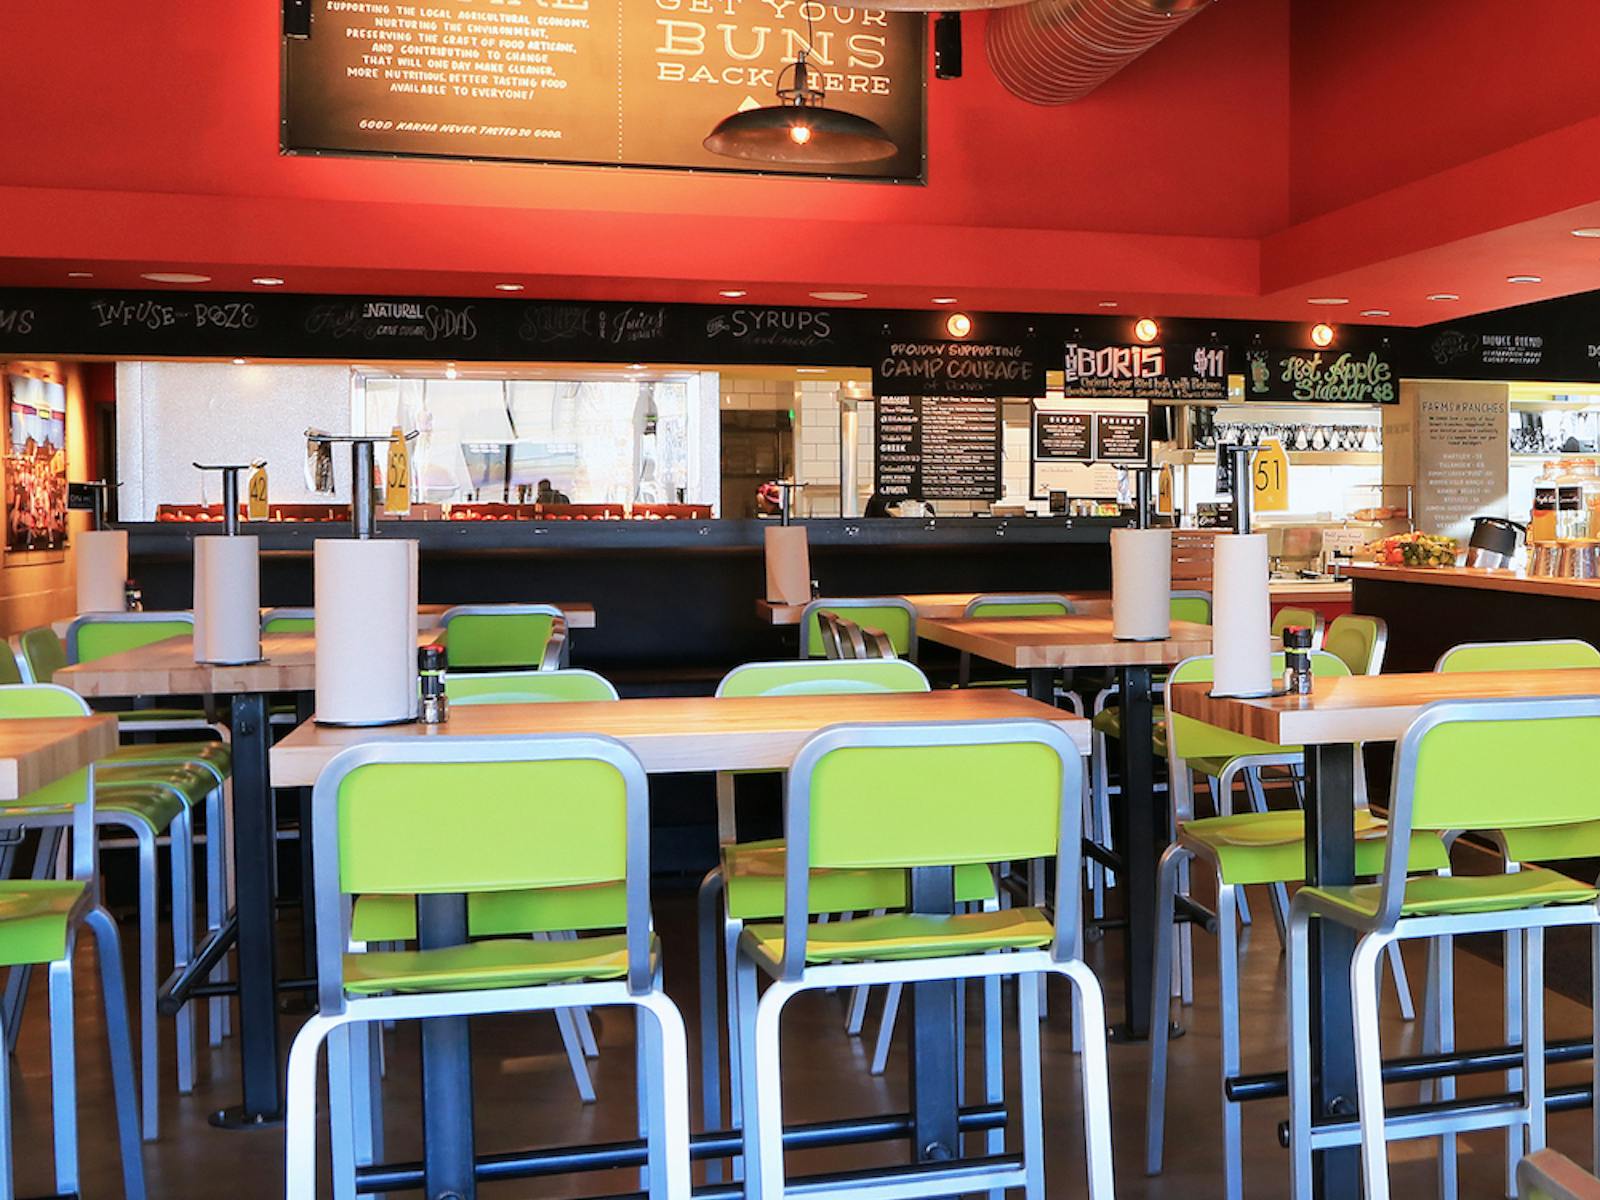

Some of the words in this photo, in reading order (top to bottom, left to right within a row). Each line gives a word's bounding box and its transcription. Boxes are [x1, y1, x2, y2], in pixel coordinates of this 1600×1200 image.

[326, 1, 390, 14] SUPPORTING
[396, 6, 415, 16] THE
[421, 8, 451, 19] LOCAL
[457, 11, 530, 24] AGRICULTURAL
[762, 0, 887, 27] YOUR
[374, 17, 437, 31] NURTURING
[443, 22, 462, 32] THE
[346, 28, 412, 42] PRESERVING
[418, 33, 438, 43] THE
[443, 35, 477, 47] CRAFT
[480, 38, 495, 47] OF
[499, 39, 525, 49] FOOD
[656, 19, 886, 69] BUNS
[362, 55, 392, 65] THAT
[397, 57, 421, 67] WILL
[427, 59, 448, 69] ONE
[451, 61, 471, 71] DAY
[475, 62, 504, 73] MAKE
[372, 43, 394, 53] AND
[401, 45, 480, 58] CONTRIBUTING
[487, 50, 501, 60] TO
[505, 52, 548, 63] CHANGE
[347, 67, 379, 78] MORE
[449, 74, 488, 84] BETTER
[493, 75, 538, 88] TASTING
[541, 79, 567, 88] FOOD
[656, 62, 774, 87] BACK
[390, 83, 447, 95] AVAILABLE
[453, 86, 468, 95] TO
[472, 87, 534, 100] EVERYONE!
[359, 119, 392, 130] GOOD
[396, 122, 436, 132] KARMA
[439, 124, 476, 134] NEVER
[480, 125, 517, 136] TASTED
[518, 128, 531, 137] SO
[366, 303, 424, 319] NATURAL
[425, 306, 477, 341] SODAS
[732, 310, 831, 337] SYRUPS
[891, 344, 945, 357] PROUDLY
[948, 344, 1022, 357] SUPPORTING
[1077, 346, 1164, 378] BORIS
[1193, 347, 1224, 377] $11
[881, 358, 943, 379] CAMP
[947, 359, 1033, 380] COURAGE
[1065, 343, 1078, 382] THE
[1280, 352, 1323, 382] Hot
[1324, 352, 1391, 385] Apple
[1293, 379, 1371, 401] Sidecar
[1372, 382, 1394, 402] $8
[1463, 402, 1504, 413] RANCHES
[391, 453, 407, 488] 52
[1255, 460, 1281, 491] 51
[251, 476, 266, 501] 42
